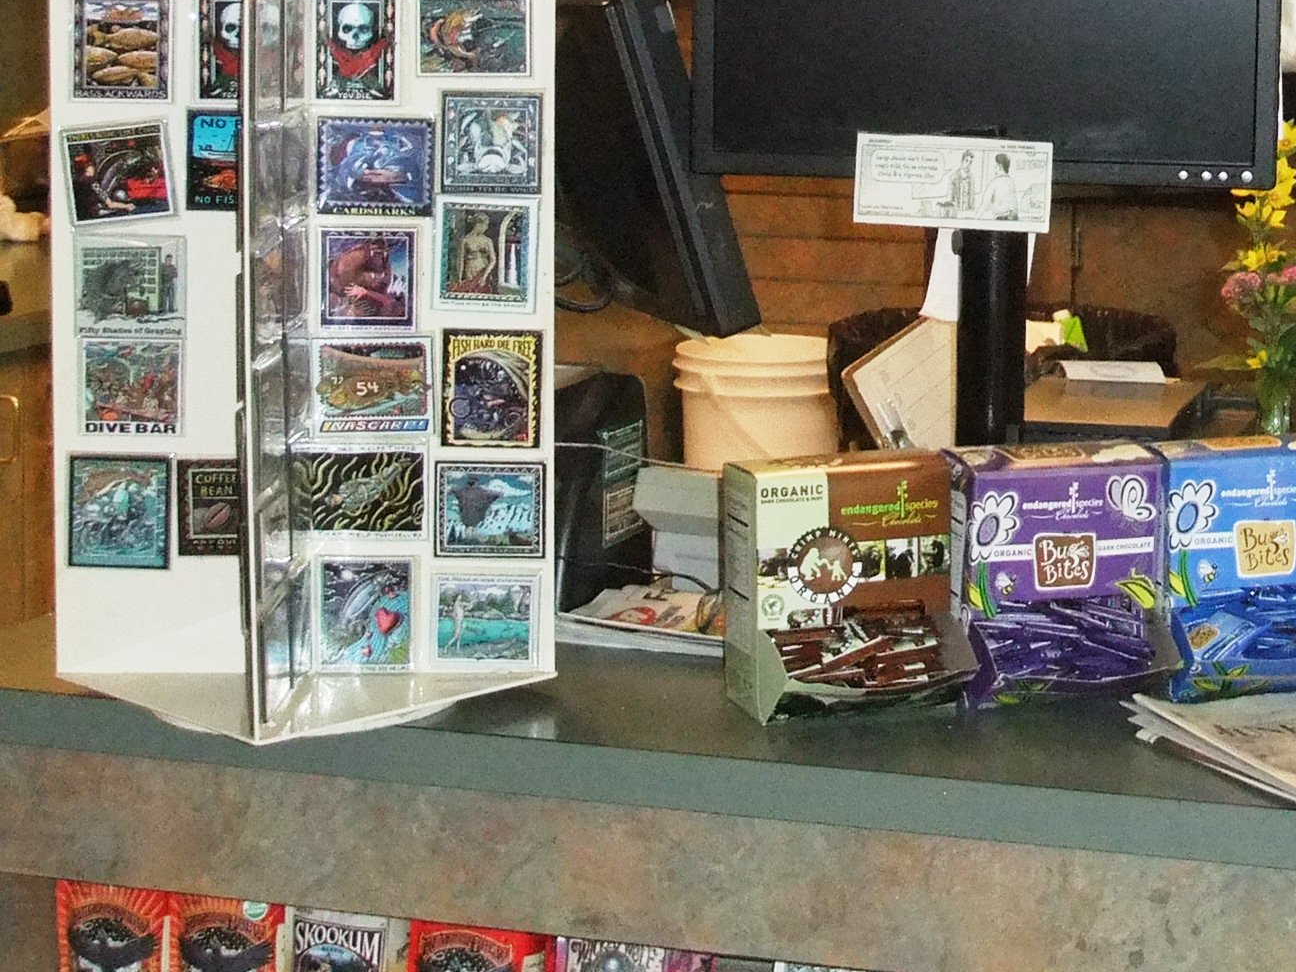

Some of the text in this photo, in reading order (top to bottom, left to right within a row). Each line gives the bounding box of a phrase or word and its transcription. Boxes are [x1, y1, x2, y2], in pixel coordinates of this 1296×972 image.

[105, 89, 166, 99] ACKWARDS
[201, 118, 226, 129] NO
[195, 195, 235, 204] NO FIS
[333, 206, 416, 216] CARDSHARKS
[79, 327, 100, 335] Fifty
[144, 327, 182, 336] Grayling
[452, 339, 532, 357] FISH HARD DIE FREE
[356, 382, 380, 396] 54
[85, 423, 177, 433] DIVE BAR
[201, 486, 233, 495] BEAN
[761, 484, 824, 498] ORGANIC
[1221, 487, 1269, 498] endangered
[841, 499, 939, 516] endangered species
[1022, 498, 1104, 511] endangered species
[1116, 542, 1151, 550] CHOCOLATE
[1194, 536, 1233, 545] ORGANIC
[993, 548, 1033, 558] ORGANIC
[1244, 548, 1290, 571] Bites
[1043, 562, 1089, 585] Bites
[294, 921, 381, 965] SKOOKUM
